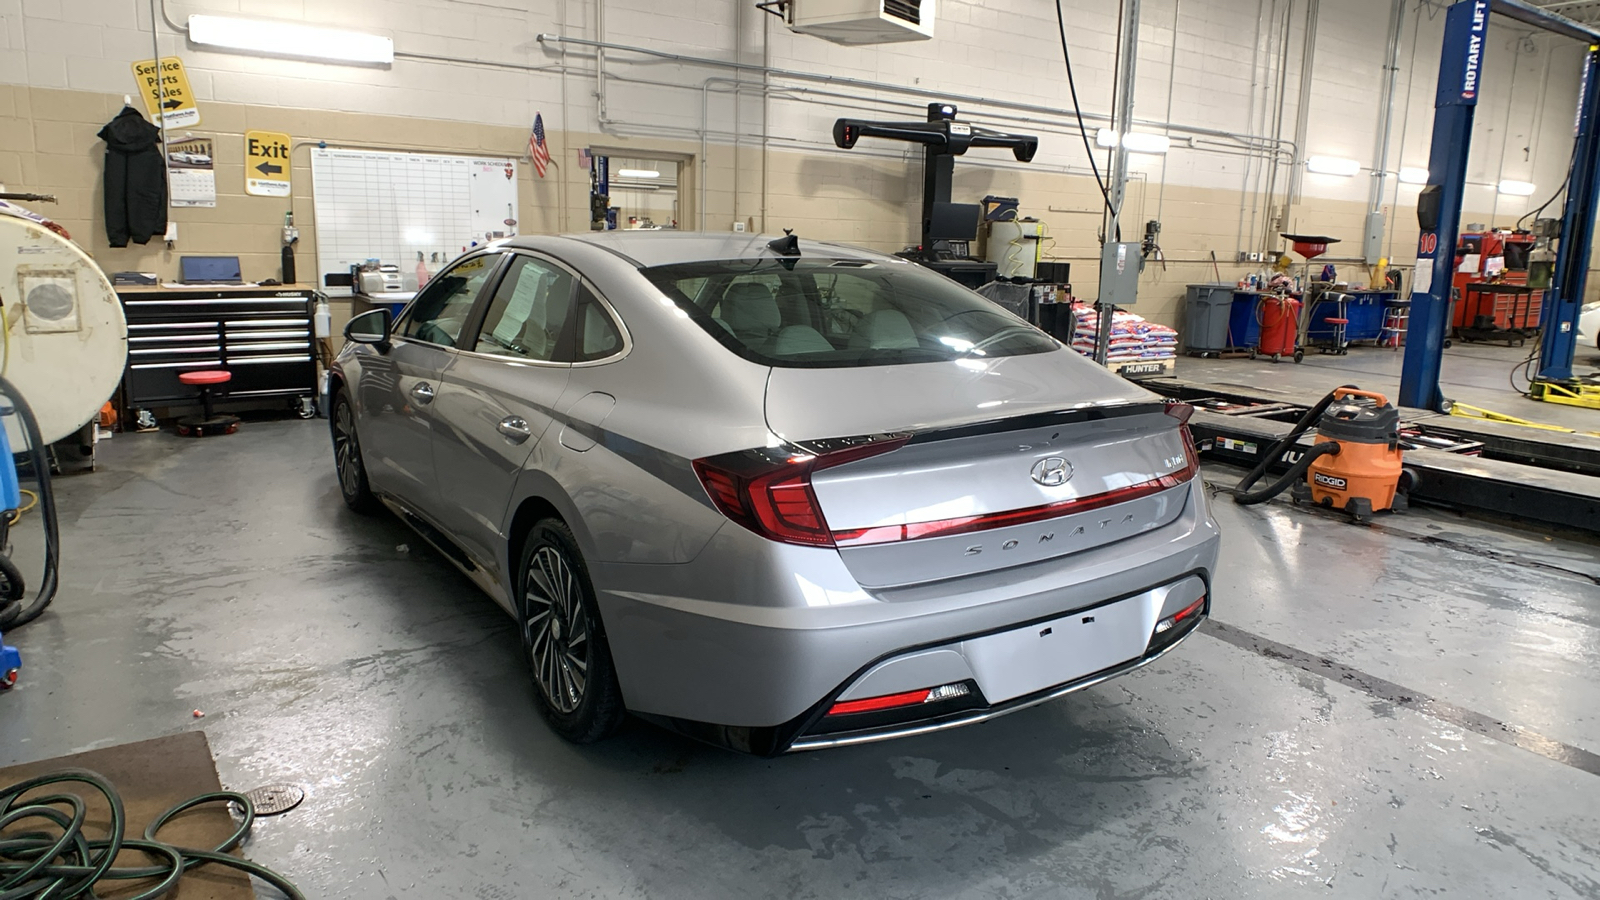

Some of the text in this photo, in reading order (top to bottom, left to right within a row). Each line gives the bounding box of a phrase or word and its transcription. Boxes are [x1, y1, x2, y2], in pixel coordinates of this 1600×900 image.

[1472, 0, 1486, 31] LIFT
[136, 62, 180, 76] Serice
[1464, 34, 1481, 91] ROTARY
[248, 138, 288, 159] Exit
[1421, 232, 1437, 254] 10
[1126, 364, 1160, 374] HUNTER
[1315, 473, 1346, 487] RIDGID
[964, 512, 1134, 557] SONATA
